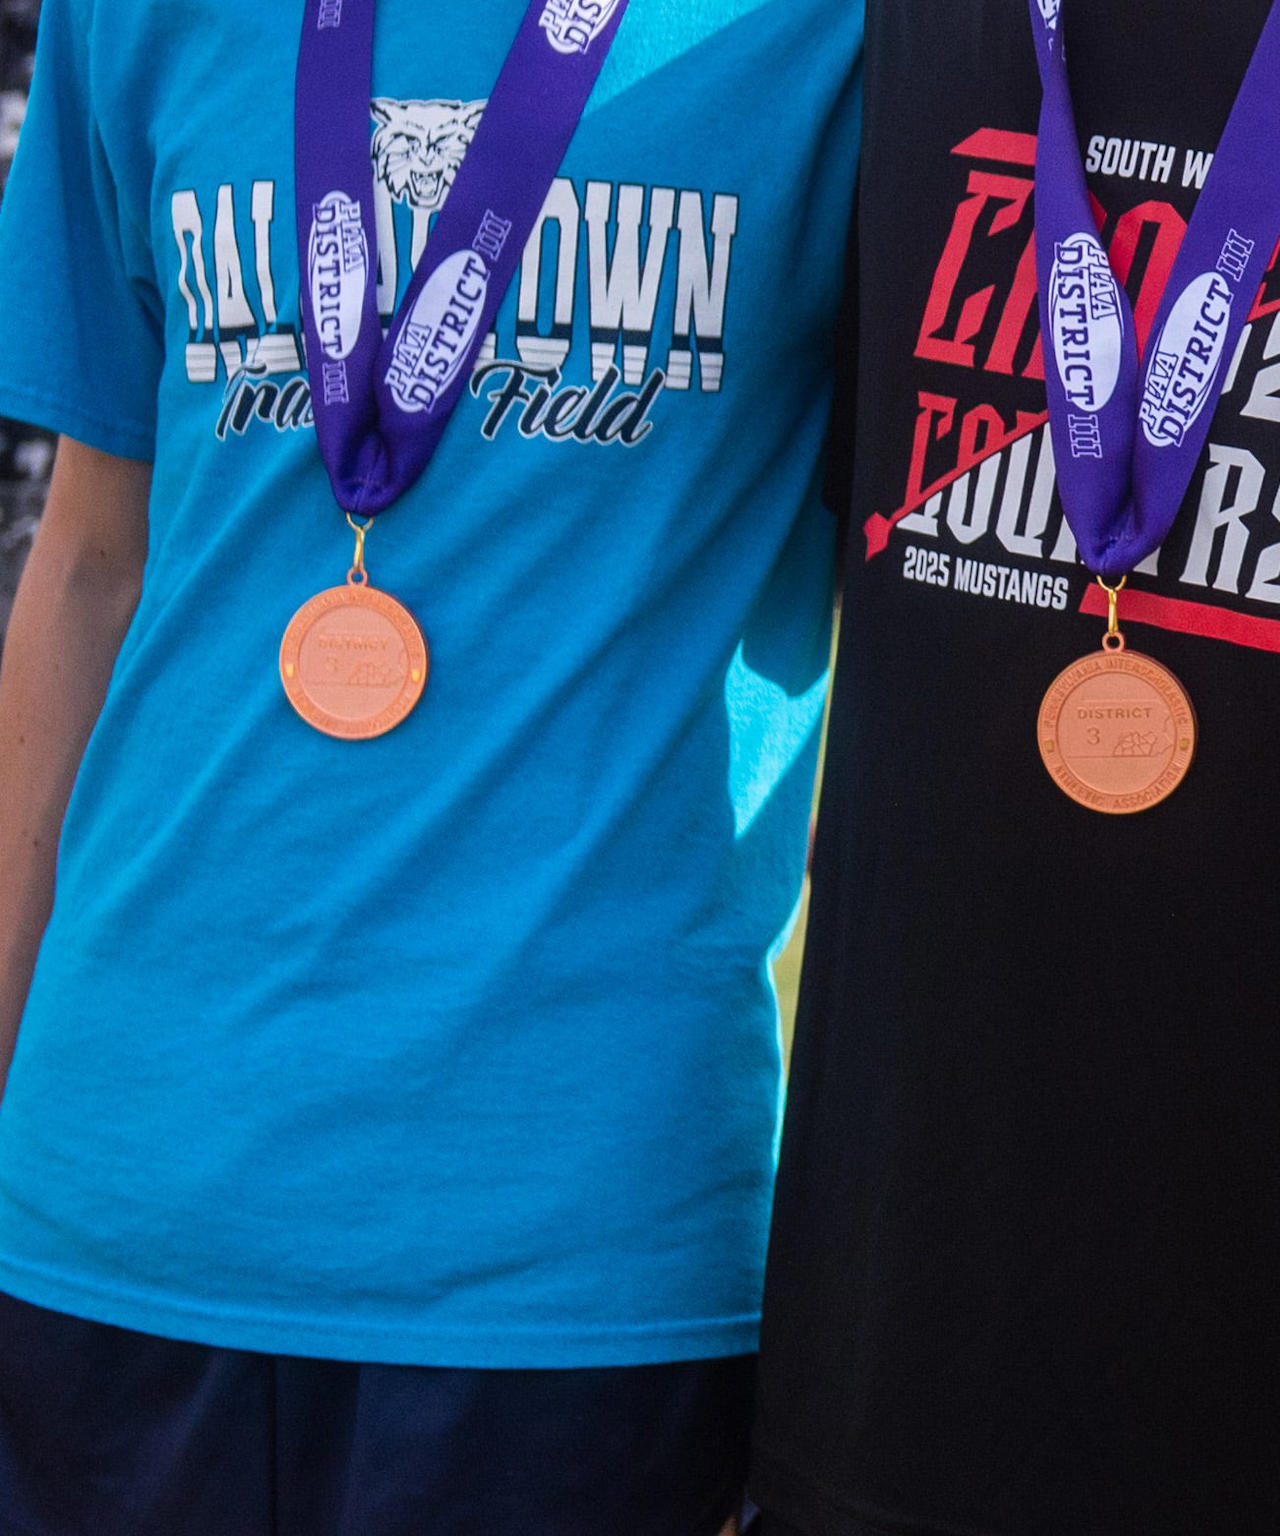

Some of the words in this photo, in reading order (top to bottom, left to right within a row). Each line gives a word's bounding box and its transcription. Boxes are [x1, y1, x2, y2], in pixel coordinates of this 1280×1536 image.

[1085, 135, 1176, 184] SOUTH
[313, 203, 343, 354] DISTRICT
[384, 322, 431, 389] PIAA
[409, 256, 491, 413] DISTRICT
[1055, 242, 1095, 406] DISTRICT
[1159, 278, 1234, 447] DISTRICT
[1216, 228, 1255, 282] III
[471, 359, 667, 446] Field
[1139, 351, 1179, 428] PIAA
[1068, 414, 1103, 458] III
[903, 545, 949, 585] 2025
[953, 557, 1069, 612] MUSTANGS
[1077, 706, 1154, 721] DISTRICT
[1087, 727, 1101, 746] 3
